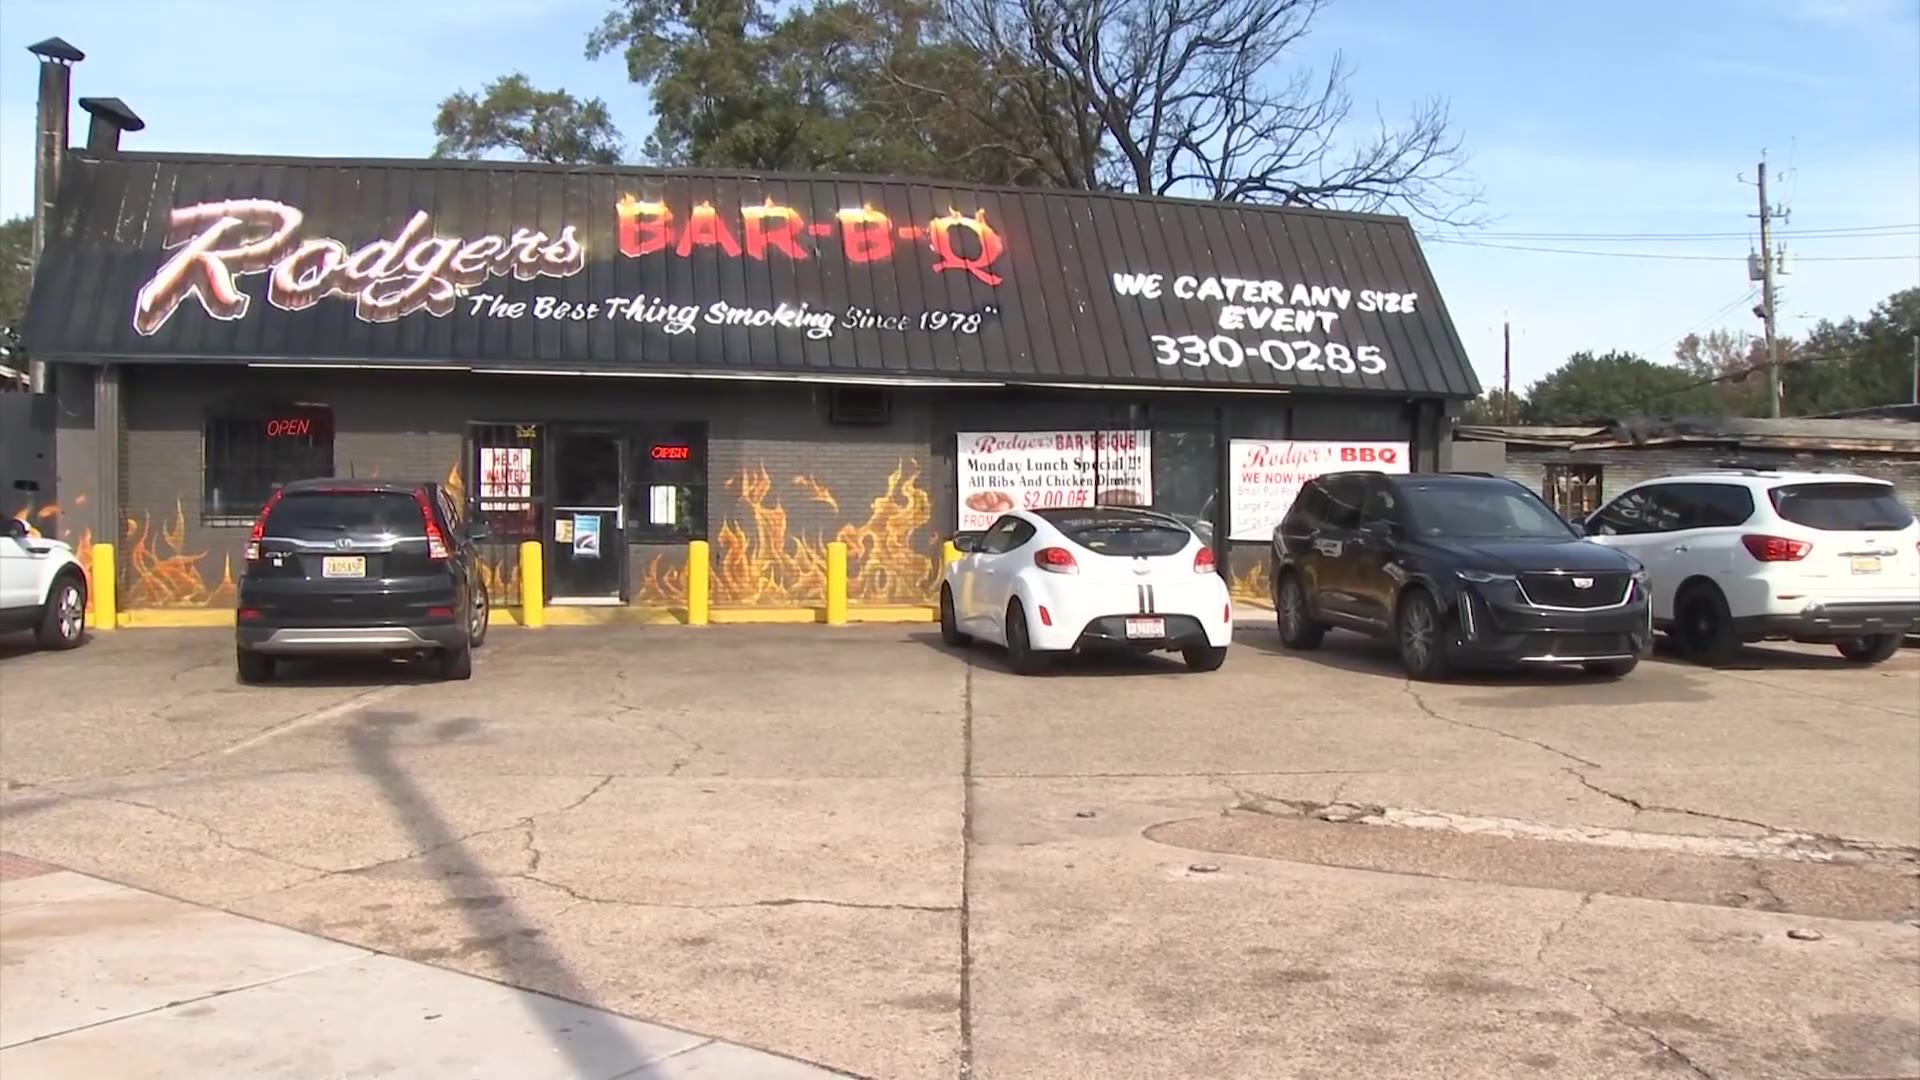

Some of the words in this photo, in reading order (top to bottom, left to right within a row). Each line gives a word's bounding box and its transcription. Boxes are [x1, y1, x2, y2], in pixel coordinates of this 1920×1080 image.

[133, 199, 585, 336] Rodgers
[616, 192, 1003, 287] BAR-B-Q
[1113, 273, 1163, 299] WE
[1173, 275, 1284, 305] CATER
[1290, 283, 1351, 310] ANY
[1357, 289, 1418, 313] SIZE
[533, 295, 600, 320] Best
[605, 293, 700, 335] Thing
[703, 300, 836, 340] Smoking
[841, 305, 910, 331] Since
[1218, 305, 1339, 333] EVENT
[1151, 335, 1387, 374] 330-0285
[267, 418, 310, 436] OPEN
[493, 453, 519, 467] HELP
[651, 446, 688, 459] OPEN
[1340, 447, 1398, 464] BBQ
[968, 457, 1021, 474] Monday
[1027, 457, 1068, 472] Lunch
[1073, 456, 1124, 473] Special
[486, 469, 528, 482] WANTED
[968, 475, 985, 488] All
[989, 475, 1015, 488] Ribs
[1019, 474, 1042, 487] And
[1046, 473, 1093, 487] Chicken
[1242, 472, 1260, 484] WE
[1265, 472, 1293, 484] NOW
[1023, 490, 1063, 508] $2.00
[1068, 490, 1089, 507] OFF
